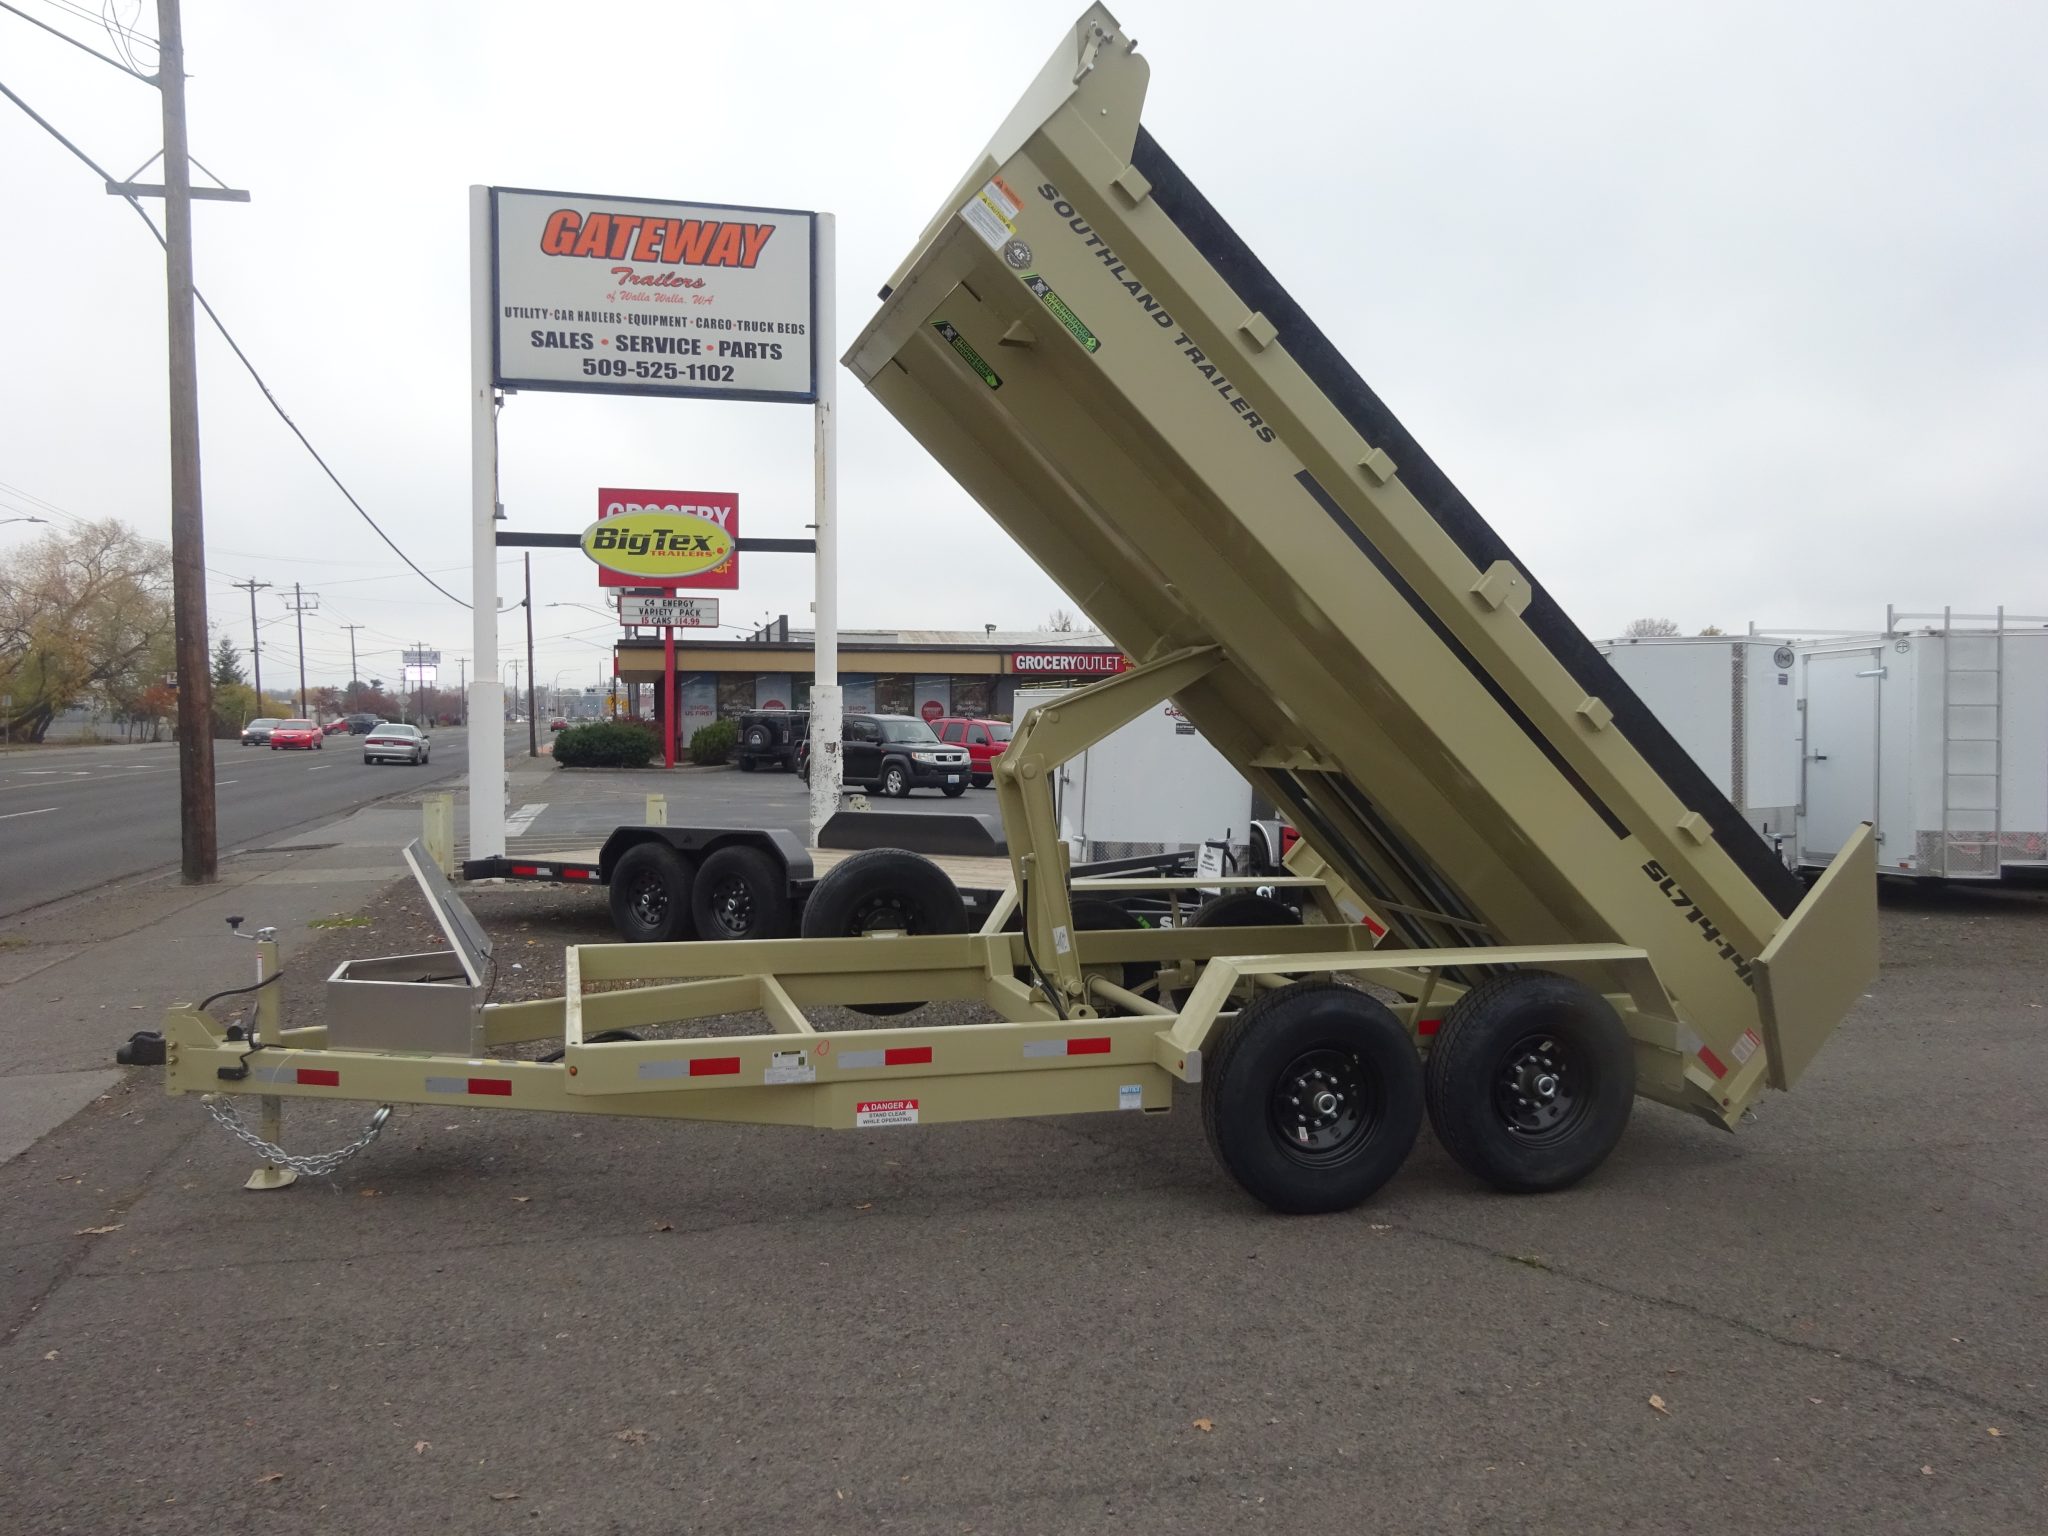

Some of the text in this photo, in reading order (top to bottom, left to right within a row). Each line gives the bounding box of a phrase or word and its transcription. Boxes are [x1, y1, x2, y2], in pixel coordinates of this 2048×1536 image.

[540, 209, 775, 268] GATEWAY
[611, 267, 706, 290] Trailers
[606, 291, 616, 303] of
[620, 290, 650, 303] Walla
[693, 295, 714, 305] WA
[504, 306, 806, 335] UTILITY CAR HAULERS EQUIPMENT CARGO TRUCK BEDS
[1037, 182, 1276, 444] SOUTHLAND TRAILERS
[531, 330, 783, 360] SALES SERVICE PARTS
[583, 358, 734, 382] 509-525-1102
[662, 600, 694, 608] ENERGY
[680, 608, 701, 617] PACK
[871, 1101, 904, 1110] DANGER
